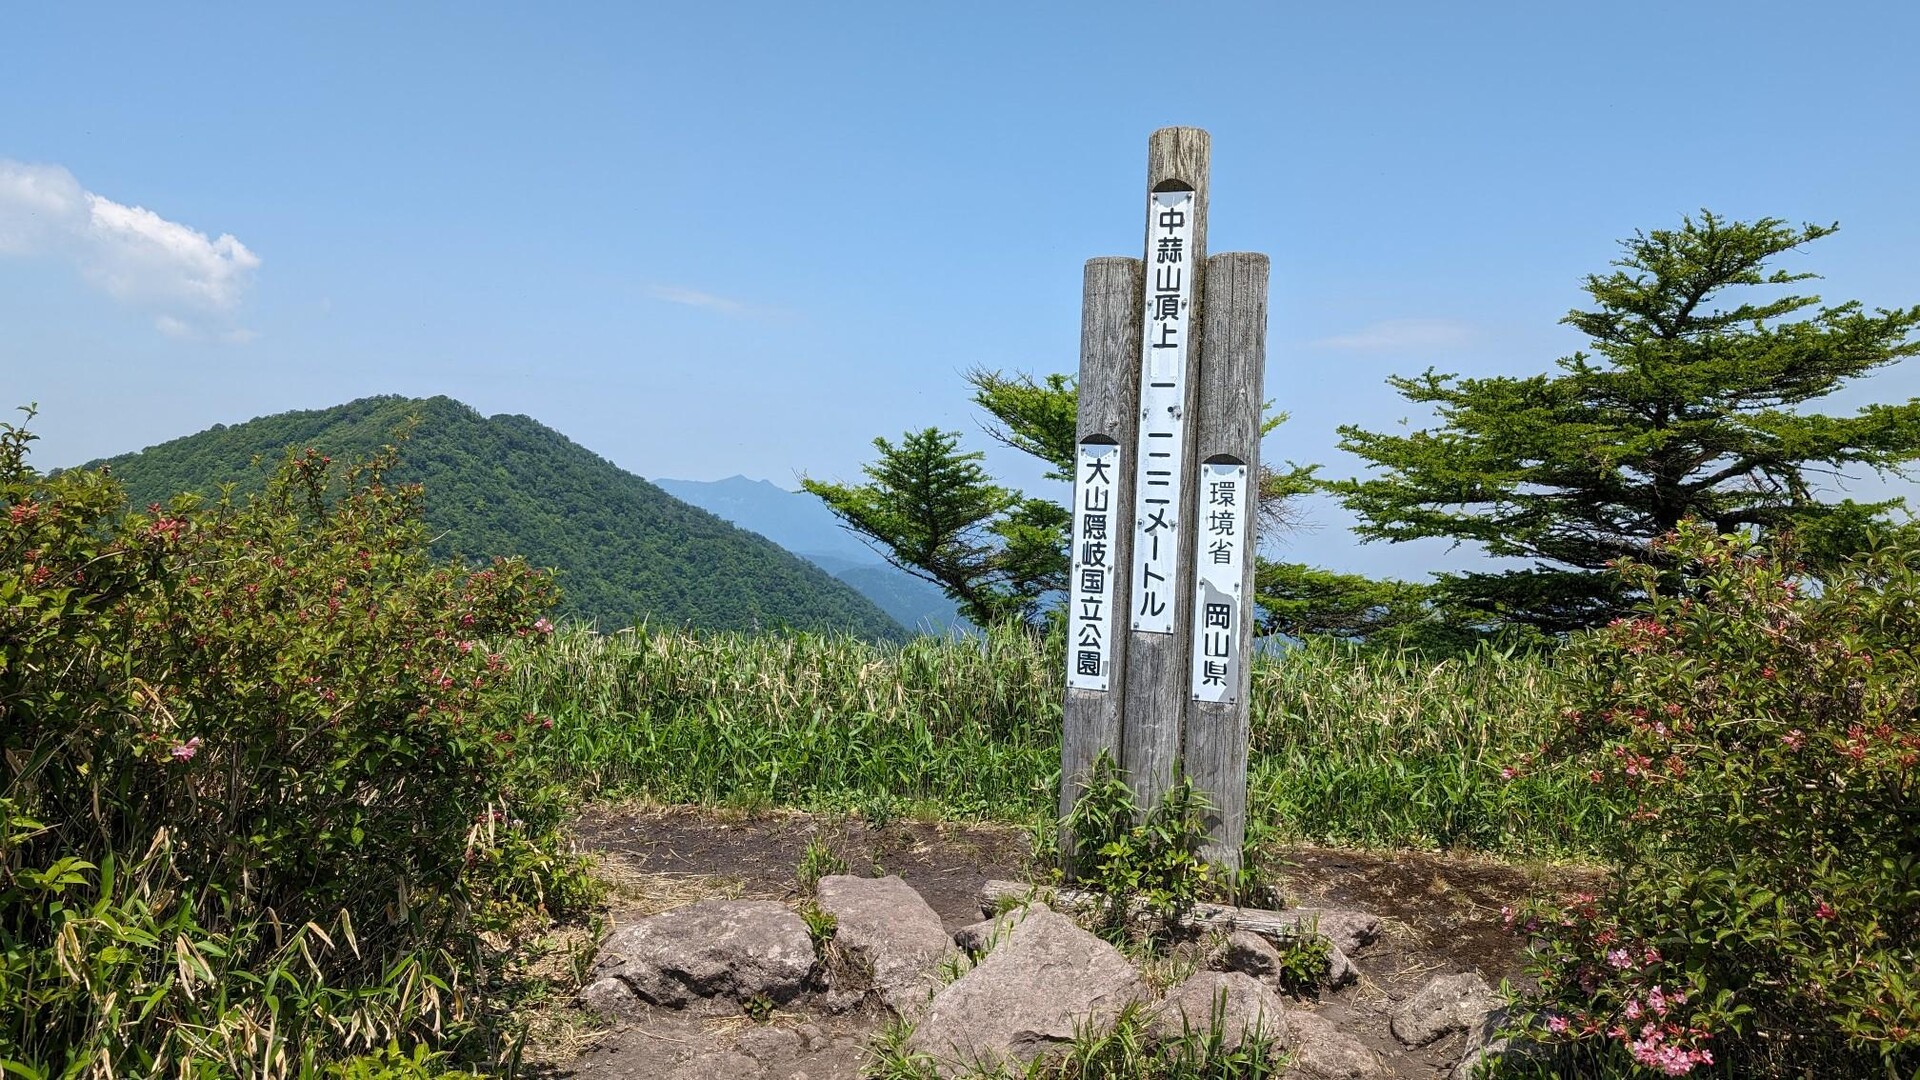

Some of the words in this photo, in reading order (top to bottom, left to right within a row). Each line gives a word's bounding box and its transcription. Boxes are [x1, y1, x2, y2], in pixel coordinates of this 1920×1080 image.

[1153, 208, 1185, 348] 中蒜山頂上
[1077, 458, 1111, 677] 大山隠岐国立公園
[1208, 481, 1236, 565] 環境省
[1202, 603, 1230, 686] 岡山県
